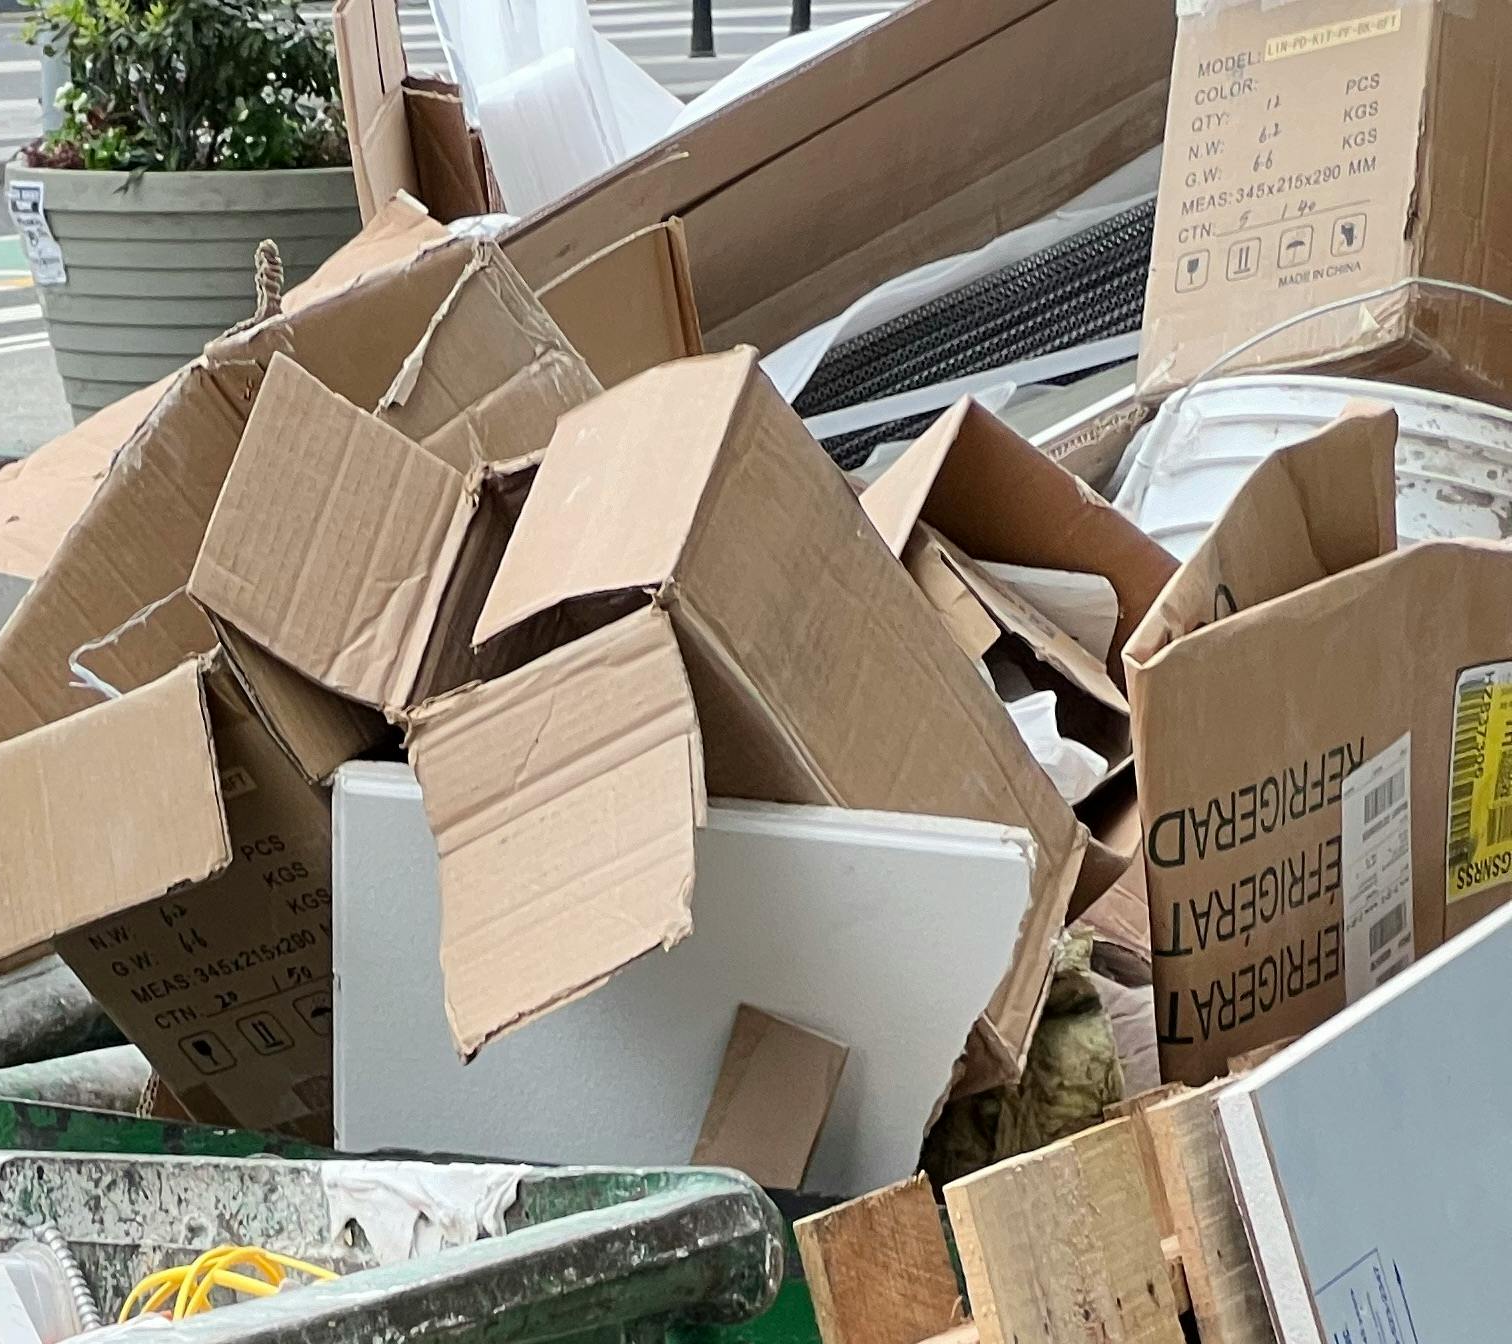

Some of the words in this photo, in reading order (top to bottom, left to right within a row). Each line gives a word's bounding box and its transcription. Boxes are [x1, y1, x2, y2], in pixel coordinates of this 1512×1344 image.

[1198, 51, 1261, 79] MODEL:
[1191, 111, 1231, 132] QTY:
[1345, 72, 1380, 95] PCS
[1195, 77, 1258, 106] COLOR:
[1343, 101, 1379, 123] KGS
[1342, 128, 1378, 150] KGS
[1348, 155, 1377, 177] MM
[1278, 269, 1311, 288] MADE
[1313, 266, 1324, 280] IN
[1326, 261, 1362, 278] CHINA
[240, 834, 286, 862] PCS
[263, 861, 309, 891] KGS
[287, 887, 331, 916] KGS
